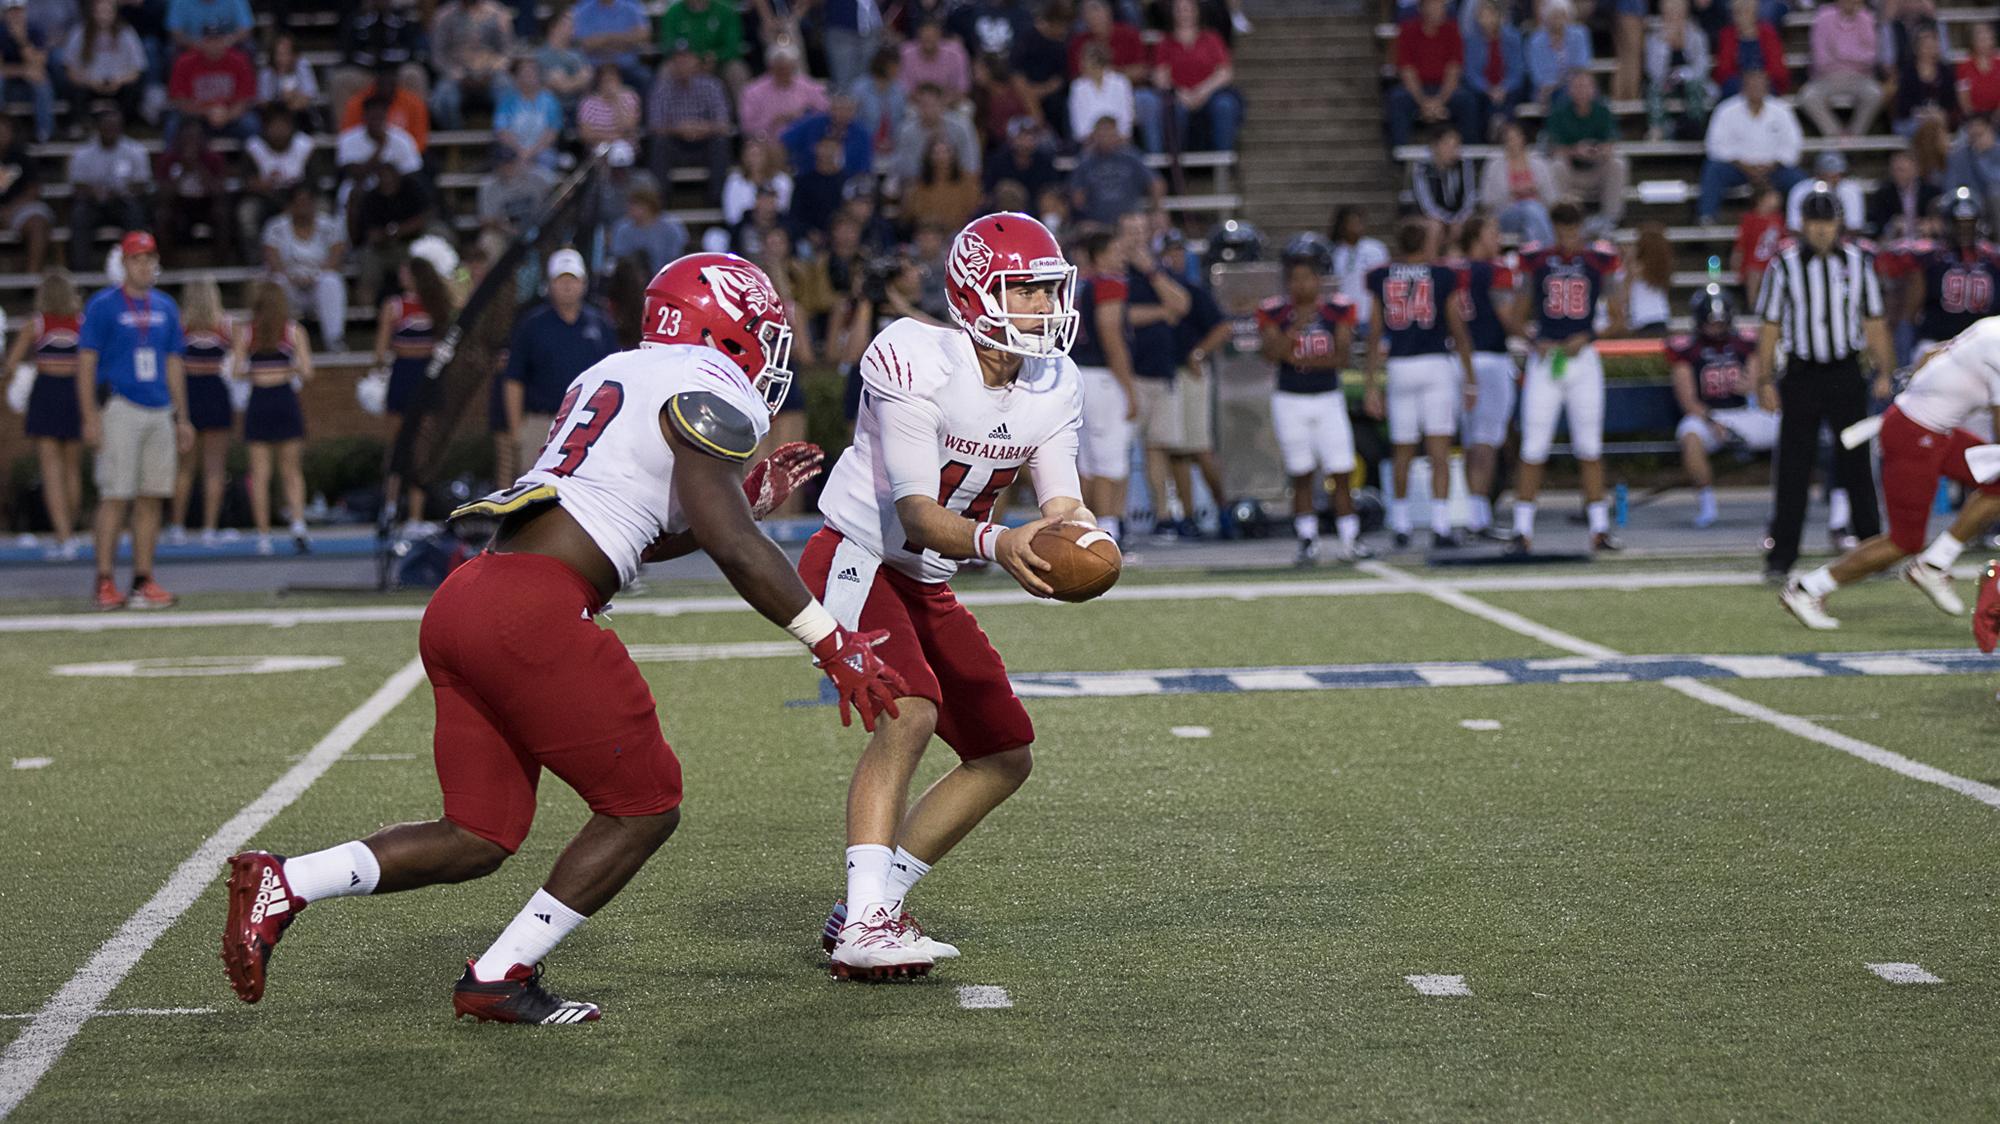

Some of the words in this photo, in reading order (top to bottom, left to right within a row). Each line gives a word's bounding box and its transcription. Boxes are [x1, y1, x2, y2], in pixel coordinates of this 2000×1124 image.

[1383, 279, 1436, 330] 54
[1941, 269, 1994, 313] 90
[656, 305, 682, 337] 23
[944, 434, 981, 455] WEST
[978, 444, 1039, 461] ALABAMA
[988, 432, 1012, 440] adidas
[837, 573, 861, 584] adidas
[250, 865, 275, 924] adidas
